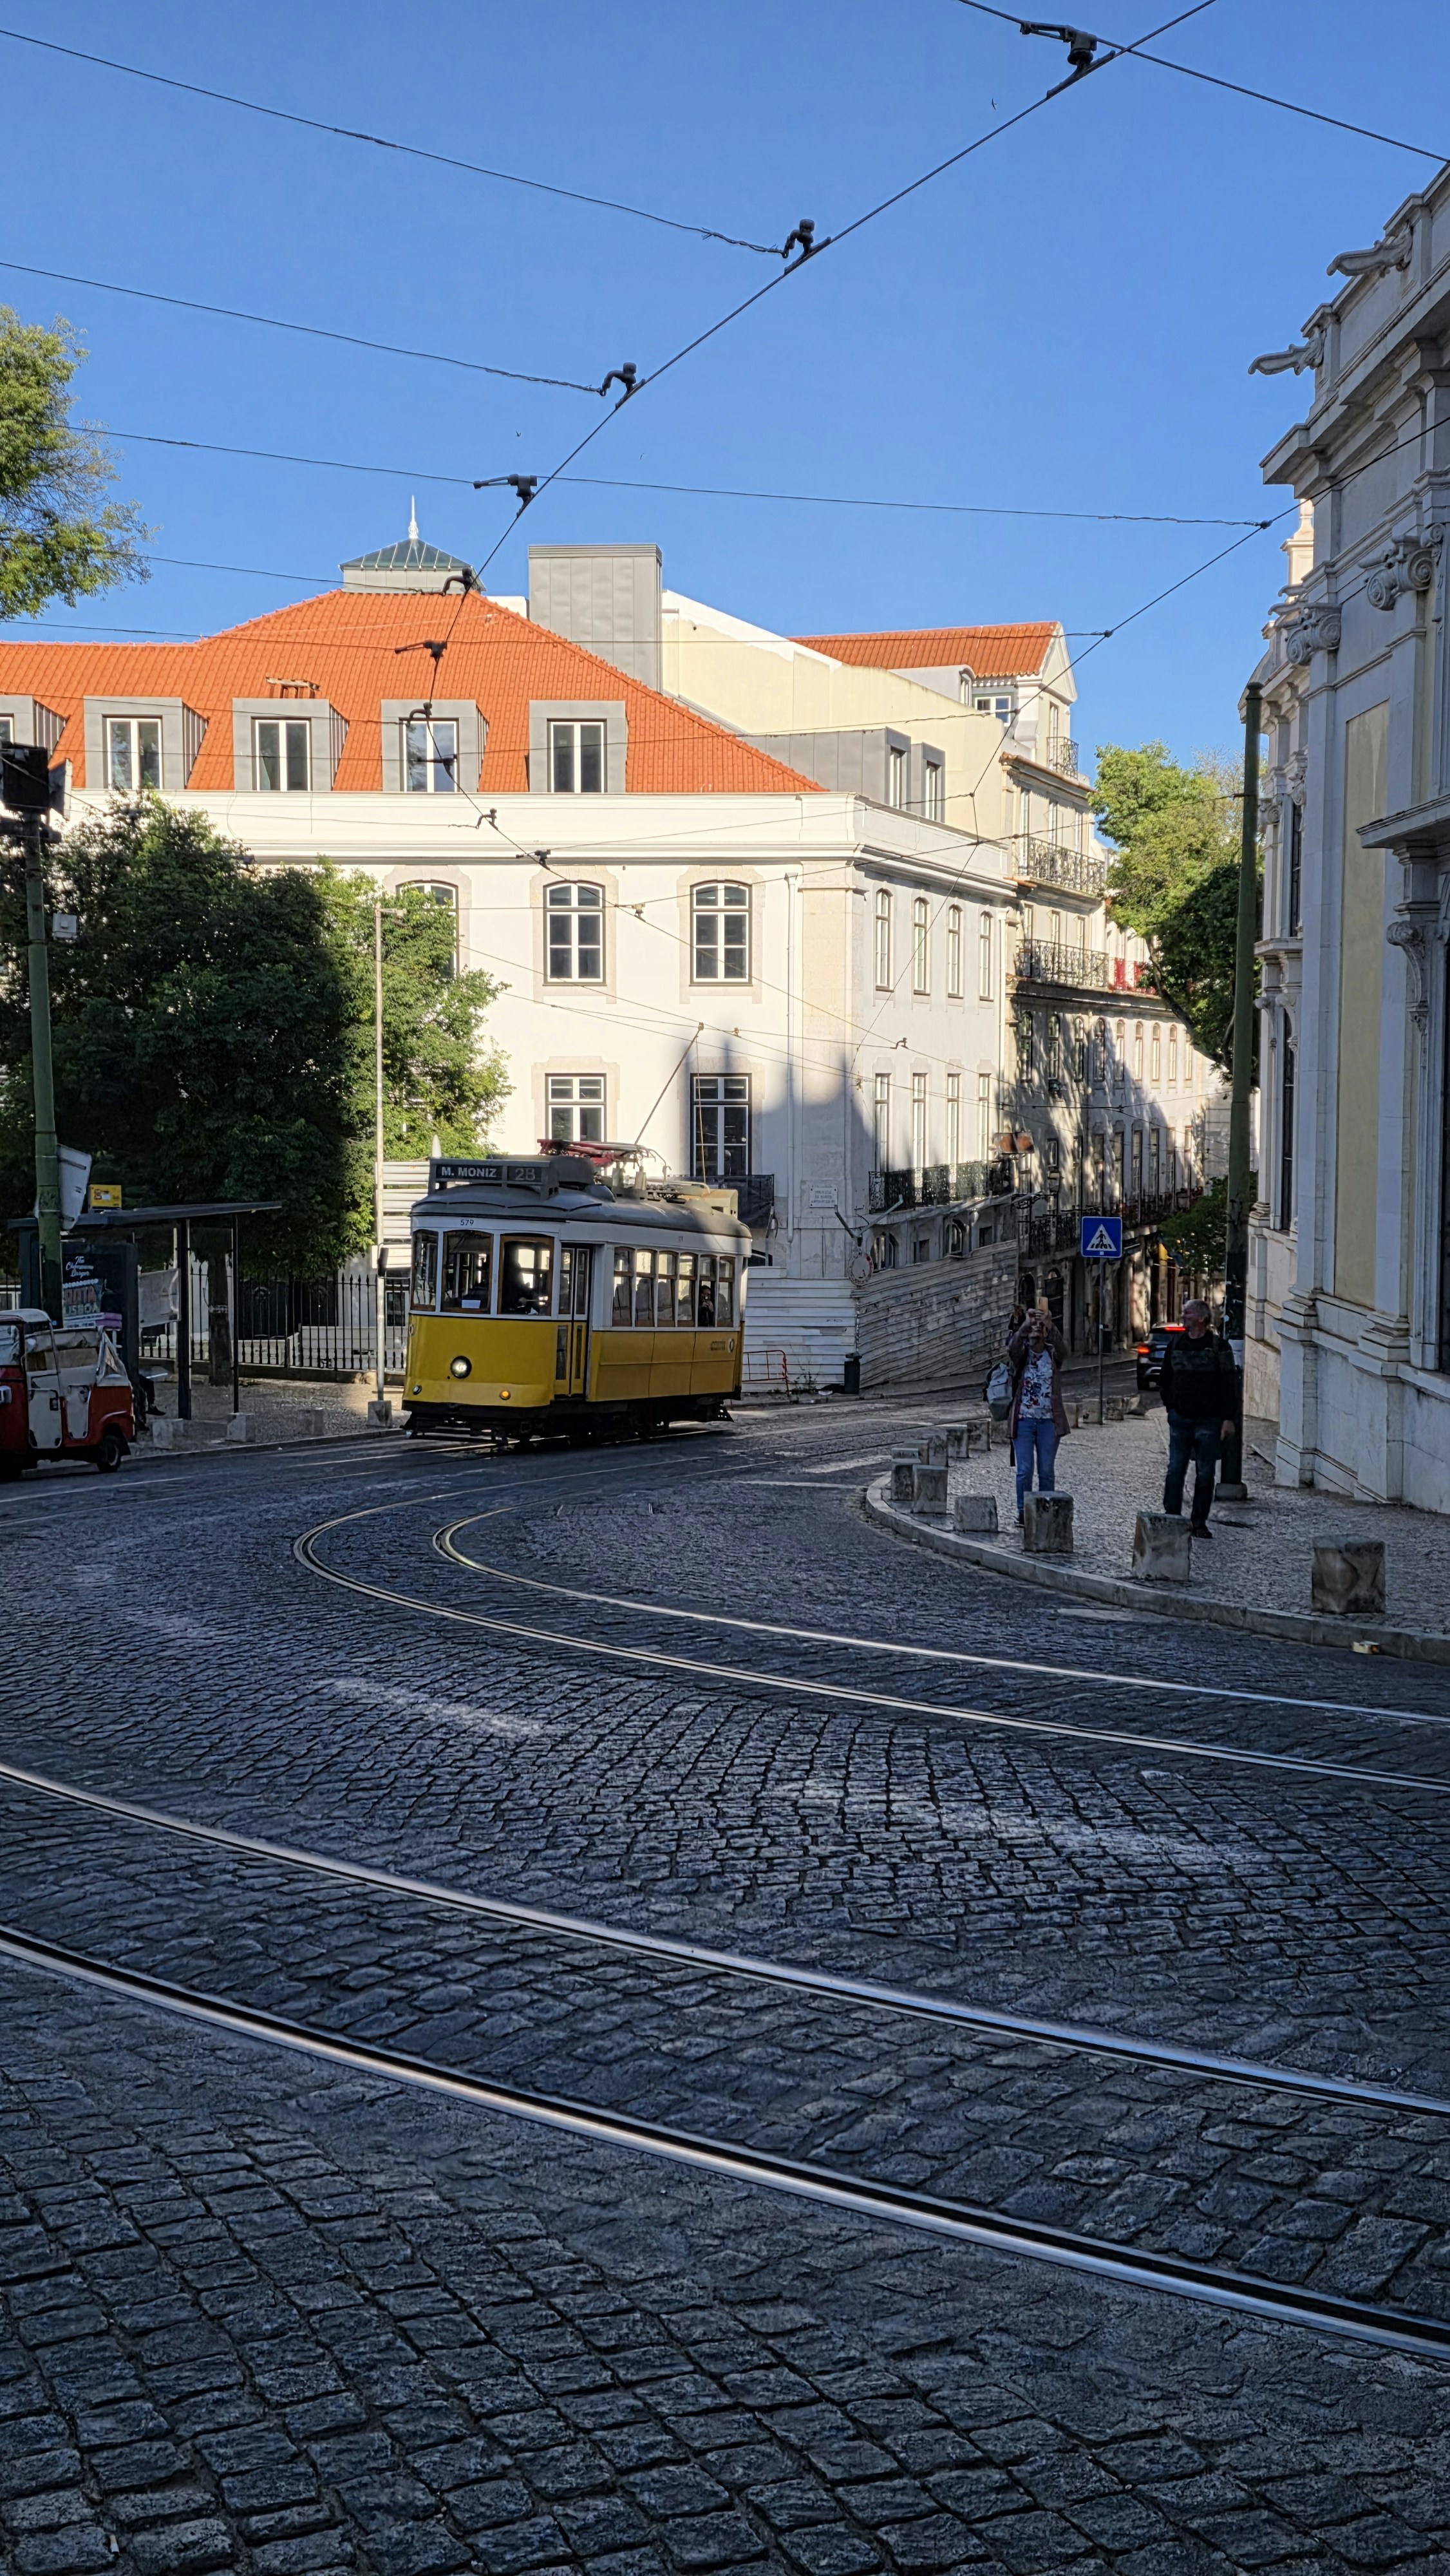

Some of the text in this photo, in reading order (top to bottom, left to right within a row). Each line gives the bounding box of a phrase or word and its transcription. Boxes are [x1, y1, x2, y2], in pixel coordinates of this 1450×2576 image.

[442, 1166, 535, 1181] M. MONIZ 28
